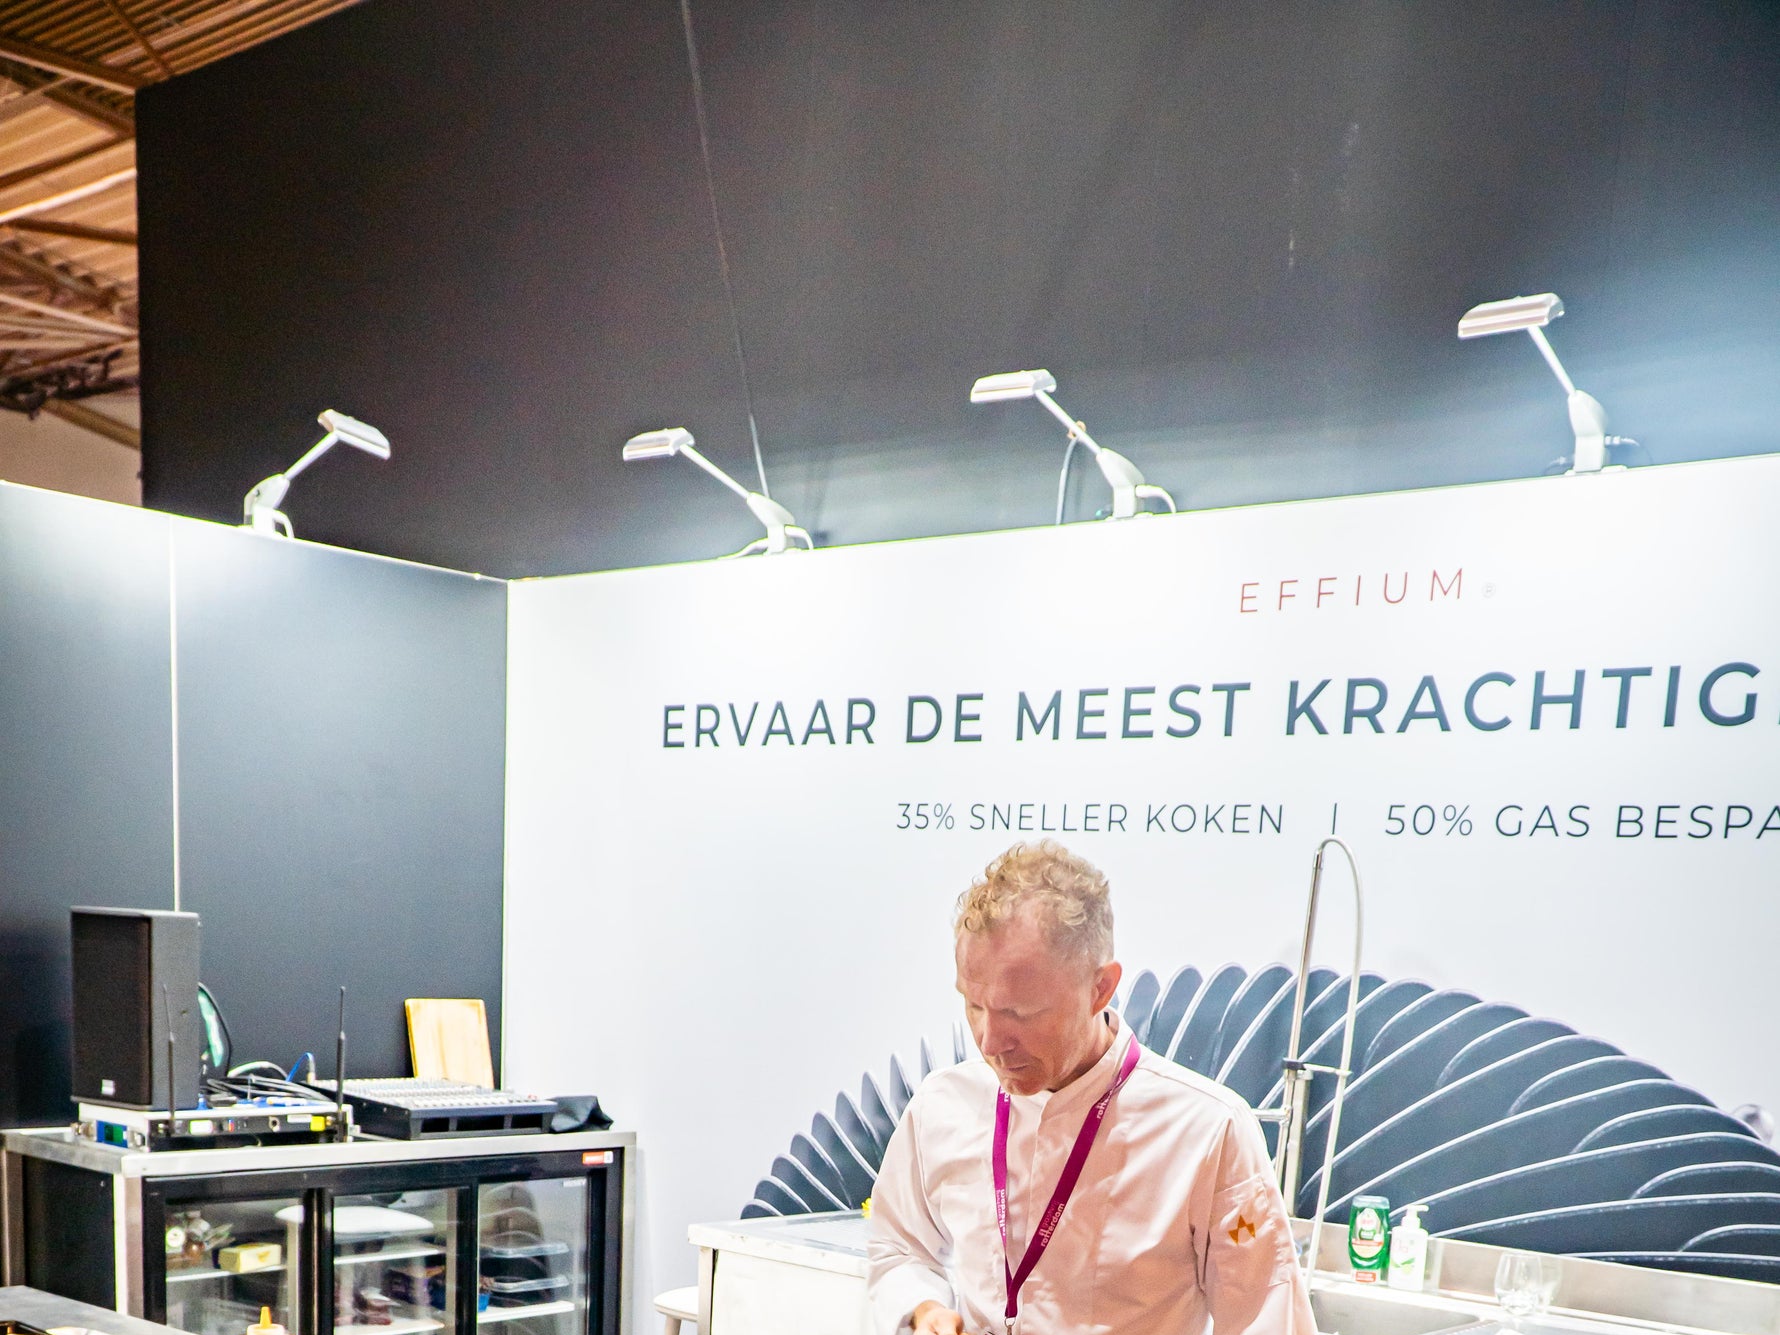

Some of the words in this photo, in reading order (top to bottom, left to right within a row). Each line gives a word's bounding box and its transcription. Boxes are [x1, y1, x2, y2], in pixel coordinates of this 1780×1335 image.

[662, 698, 876, 748] ERVAAR
[906, 693, 984, 743] DE
[1016, 678, 1251, 742] MEEST
[1285, 661, 1780, 736] KRACHTIG
[896, 803, 955, 830] 35%
[969, 803, 1128, 832] SNELLER
[1146, 804, 1283, 833] KOKEN
[1384, 804, 1473, 837] 50%
[1495, 804, 1591, 838] GAS
